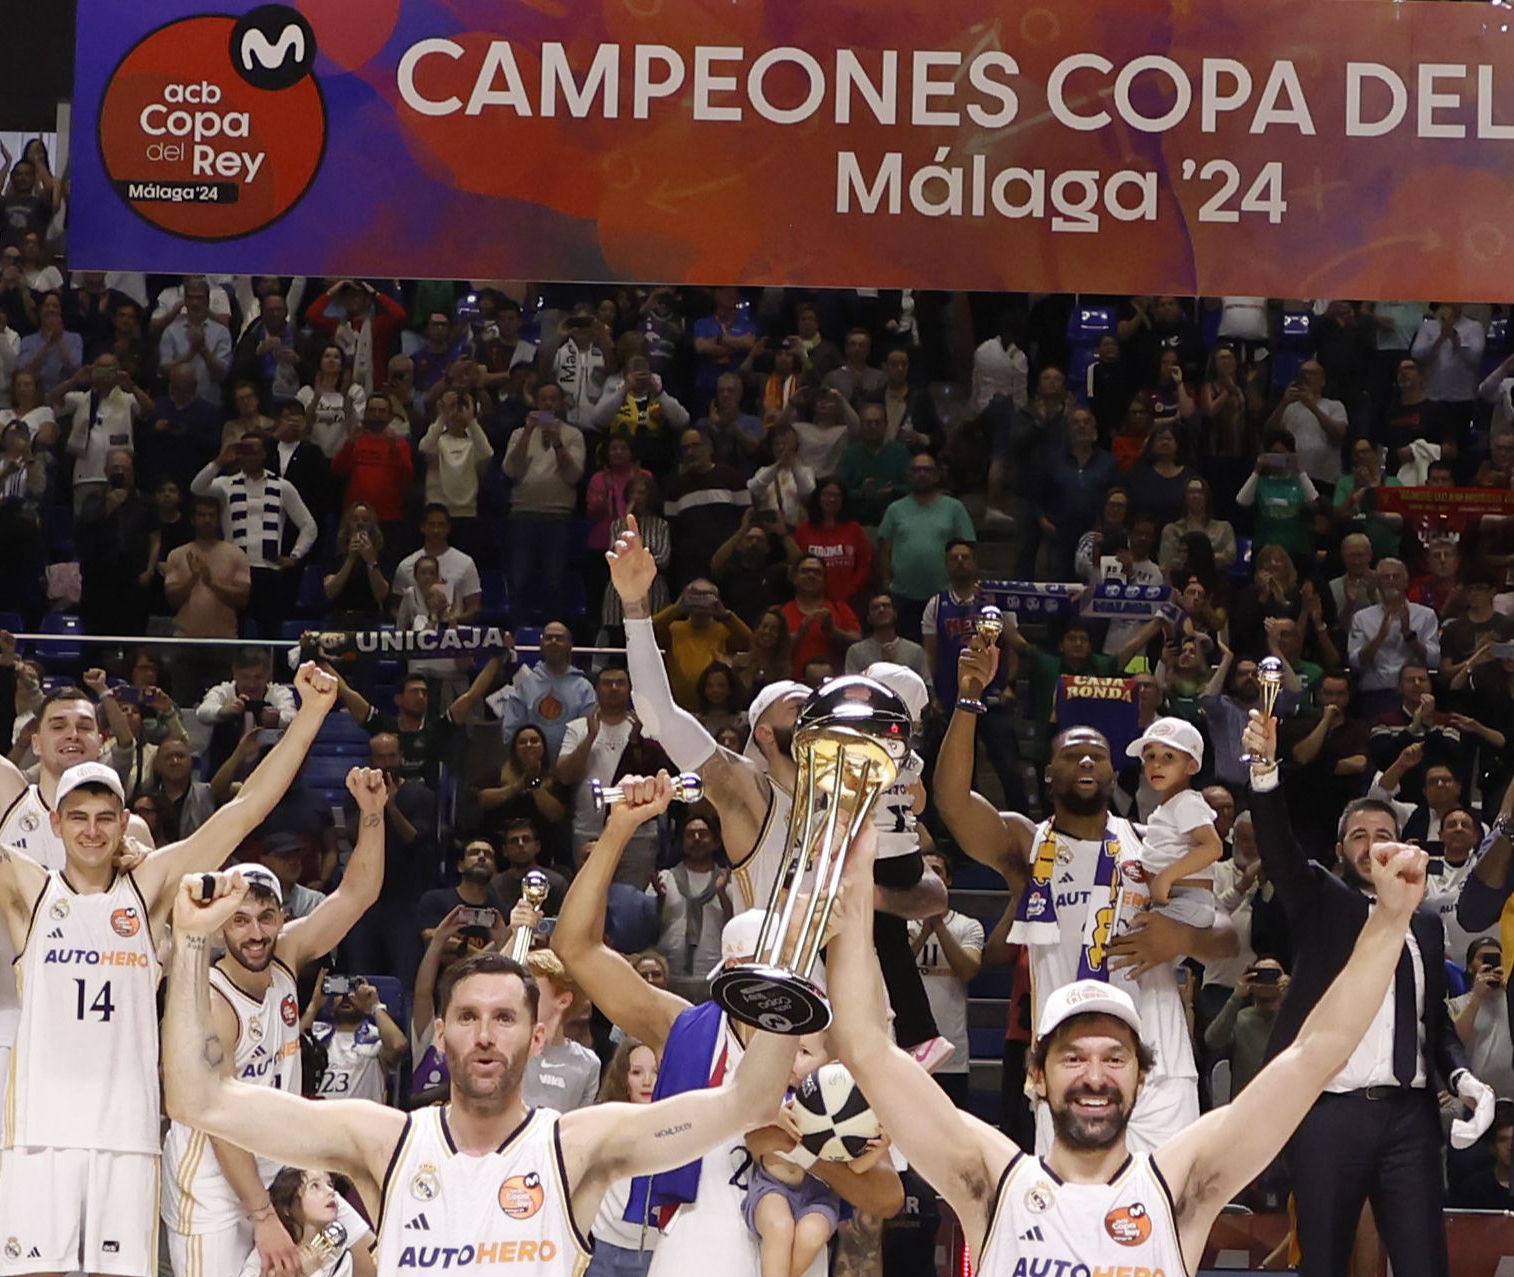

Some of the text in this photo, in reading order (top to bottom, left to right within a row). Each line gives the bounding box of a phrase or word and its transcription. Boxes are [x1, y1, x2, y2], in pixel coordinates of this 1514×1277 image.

[164, 81, 222, 104] acb
[397, 38, 1019, 130] CAMPEONES
[1047, 52, 1317, 138] COPA
[140, 104, 250, 142] Copa
[146, 142, 265, 183] del Rey
[836, 147, 1158, 231] Málaga
[355, 627, 504, 652] UNICAJA
[44, 948, 150, 968] AUTOHERO
[73, 978, 116, 1023] 14
[321, 1072, 349, 1093] 23
[398, 1240, 557, 1269] AUTOHERO
